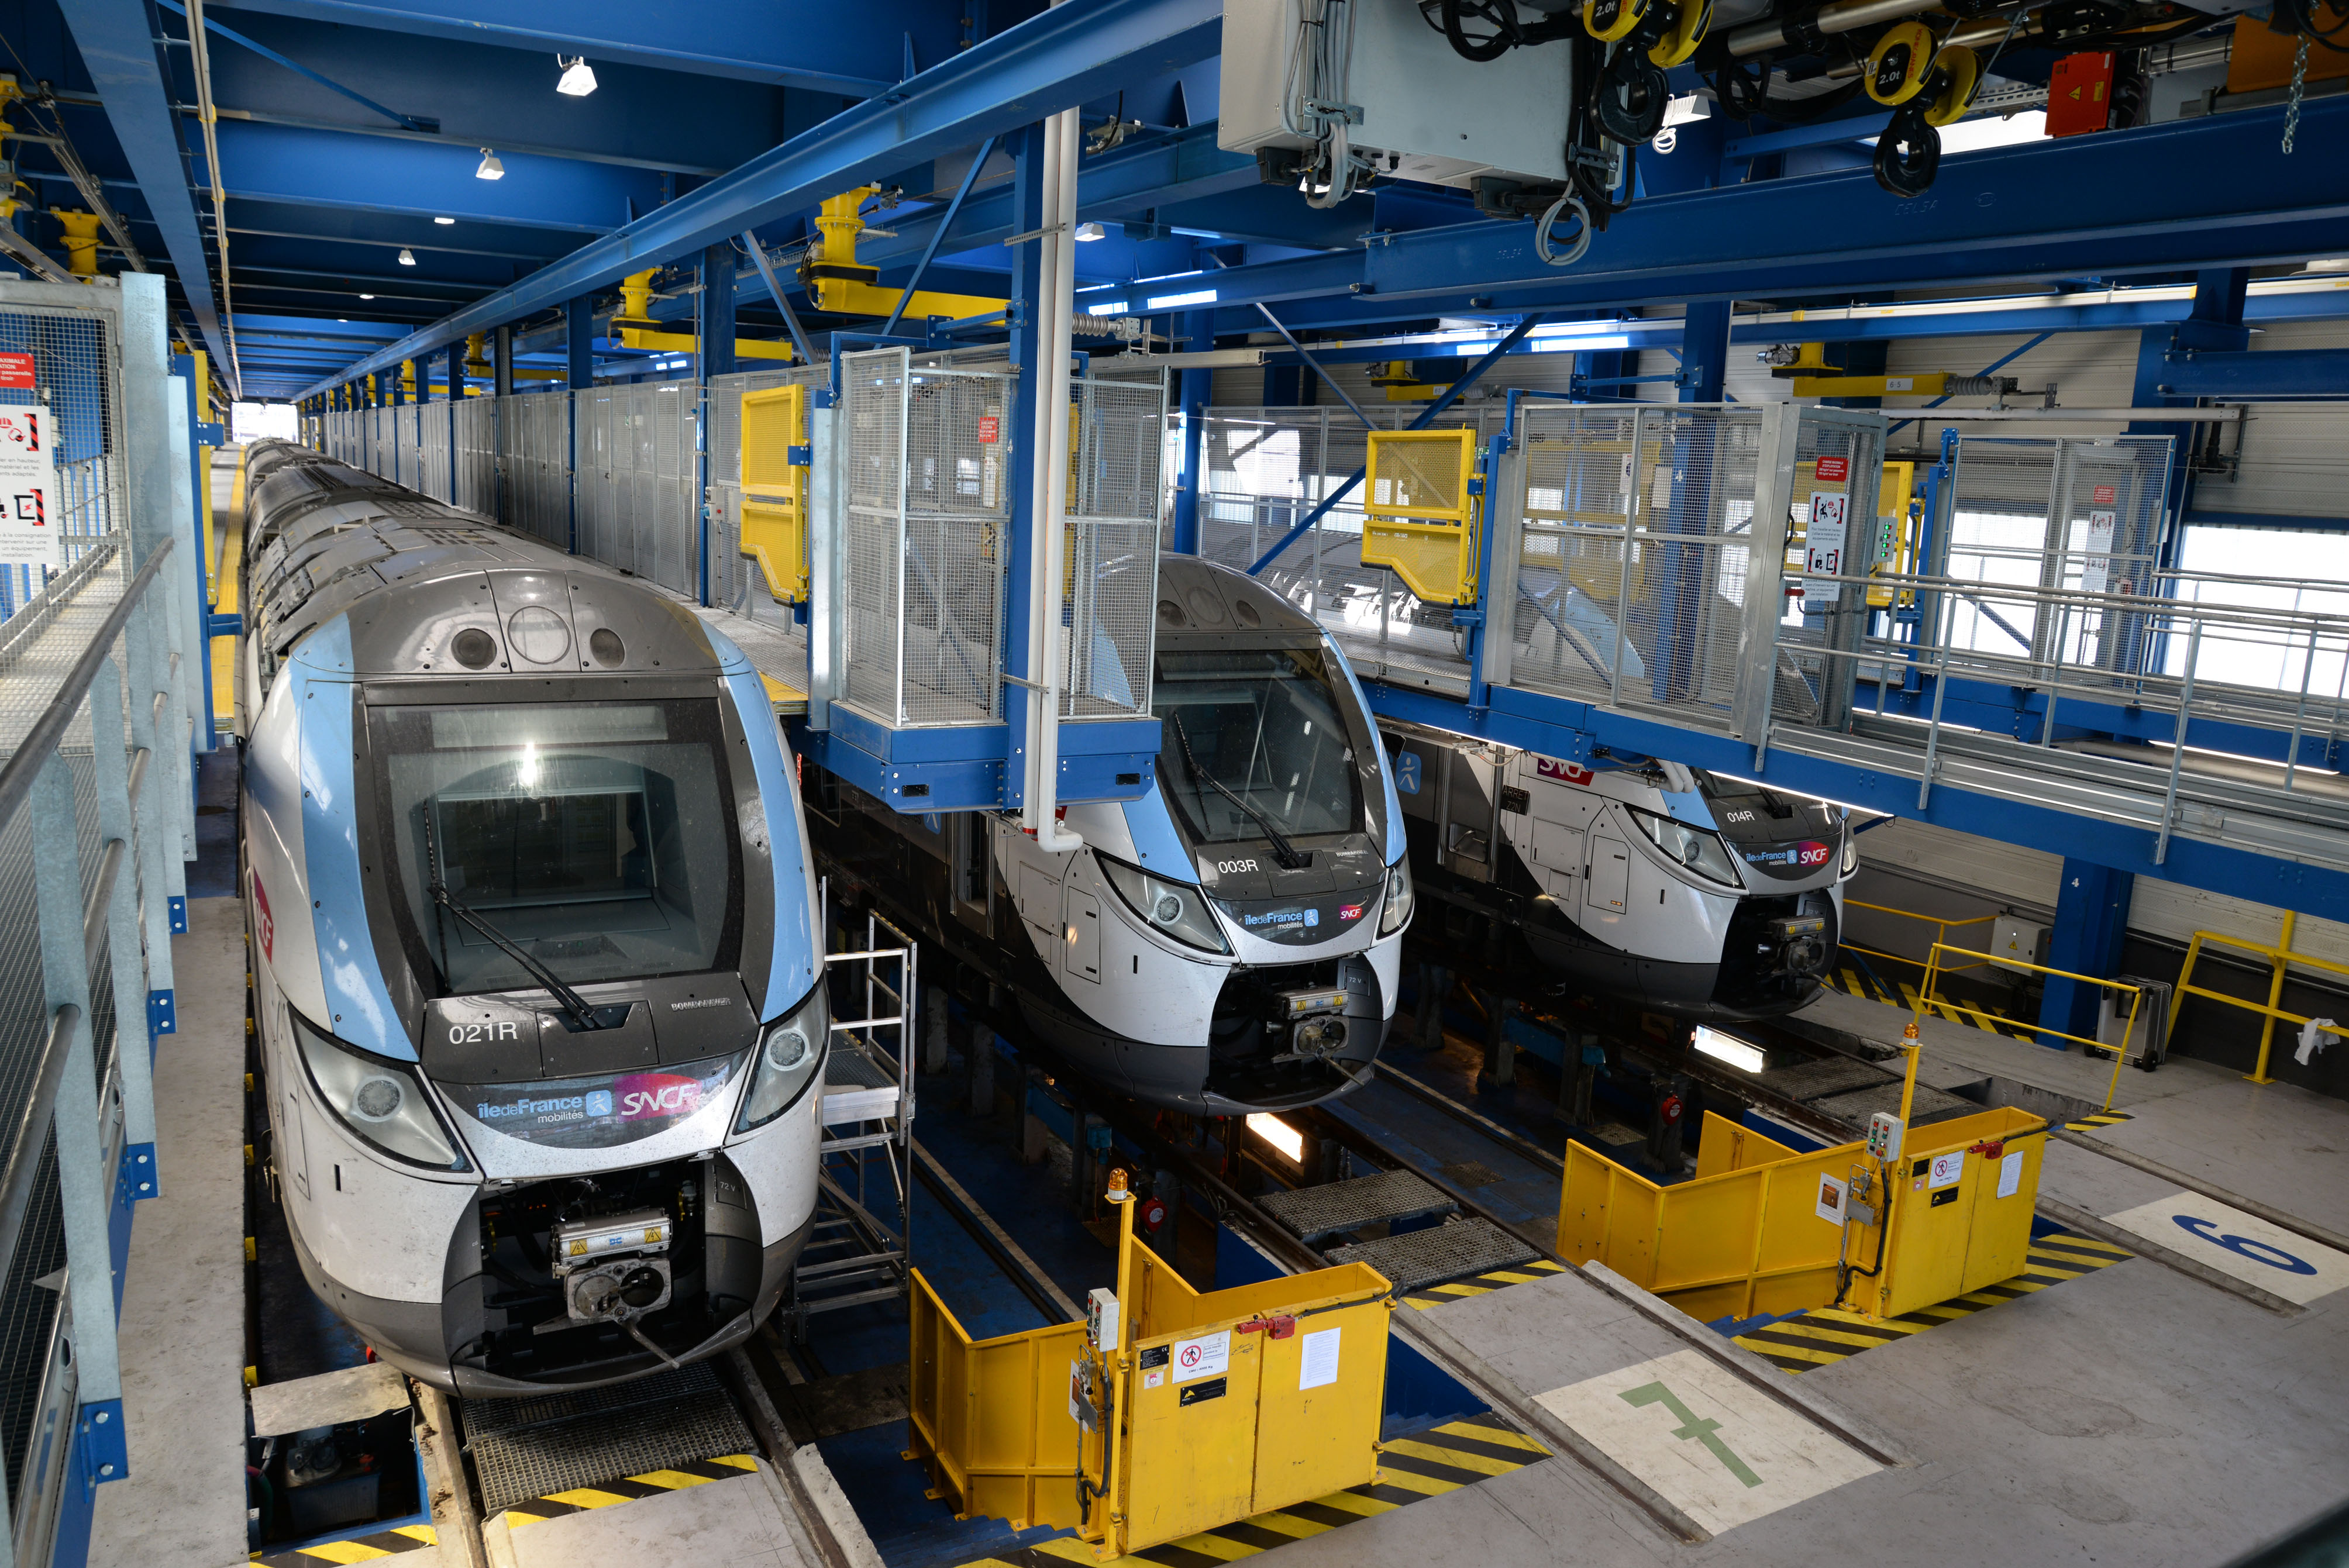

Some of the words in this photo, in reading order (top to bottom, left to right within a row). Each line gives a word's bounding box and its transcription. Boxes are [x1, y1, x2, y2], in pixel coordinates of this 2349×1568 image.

[1596, 2, 1616, 17] 2.0t
[1879, 70, 1900, 84] 2.0t
[1503, 787, 1530, 801] ARRET
[1506, 801, 1521, 812] Z2N
[1727, 811, 1755, 823] 014R
[1800, 848, 1827, 864] SNCF
[1218, 859, 1259, 874] 003R
[1341, 908, 1361, 919] SNCF
[1277, 921, 1303, 930] mobilités
[671, 997, 732, 1011] BOMBARDIER
[449, 1021, 518, 1045] 021R
[621, 1083, 697, 1116] SNCF
[538, 1110, 584, 1124] mobilités
[720, 1181, 729, 1190] 72
[2172, 1215, 2318, 1276] 6
[1617, 1380, 1764, 1489] 7
